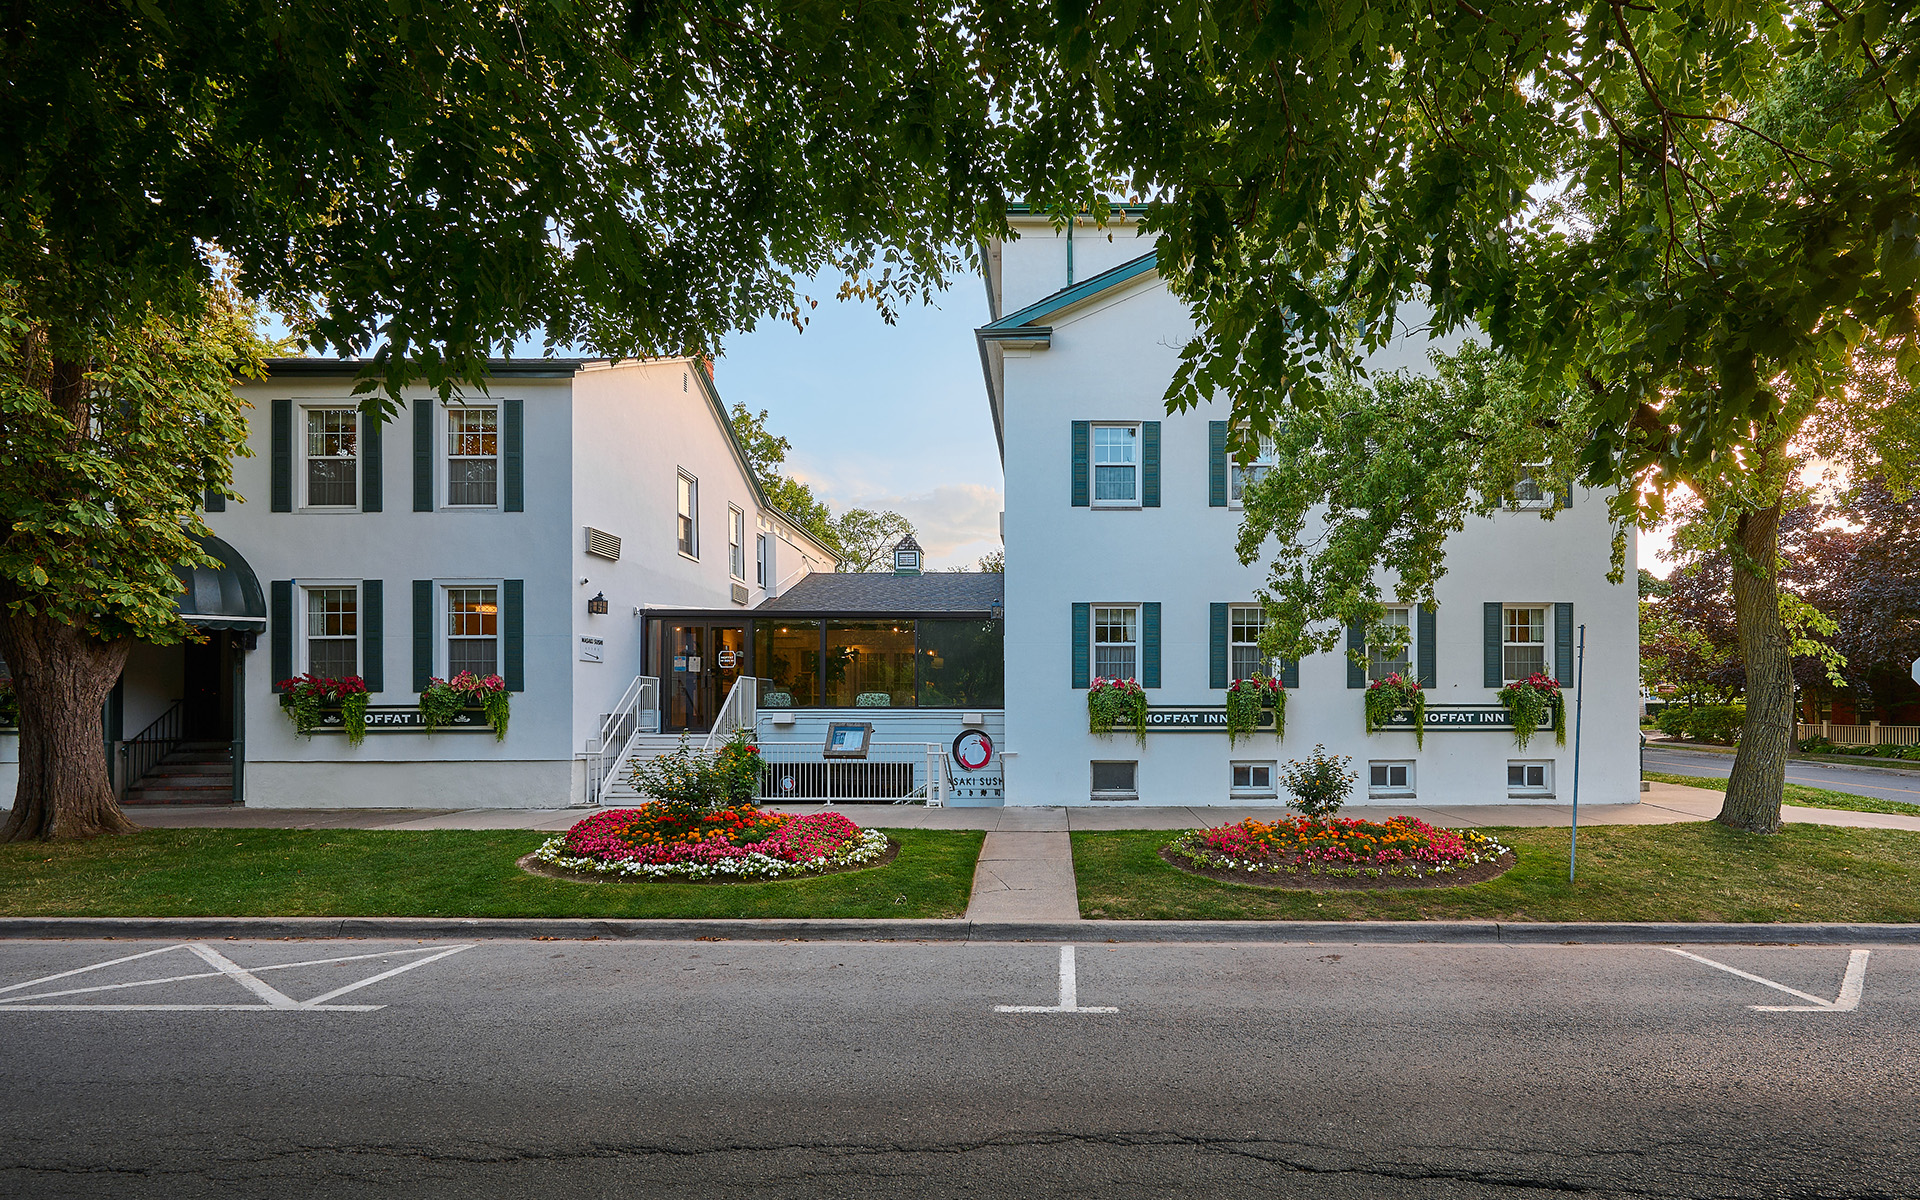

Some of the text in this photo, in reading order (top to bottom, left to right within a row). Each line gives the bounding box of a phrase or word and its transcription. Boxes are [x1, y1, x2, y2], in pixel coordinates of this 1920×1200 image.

[363, 714, 411, 724] OFFAT
[1145, 714, 1228, 723] MOFFAT INN
[1479, 713, 1505, 723] INN
[952, 777, 1004, 786] SAKI SUSH
